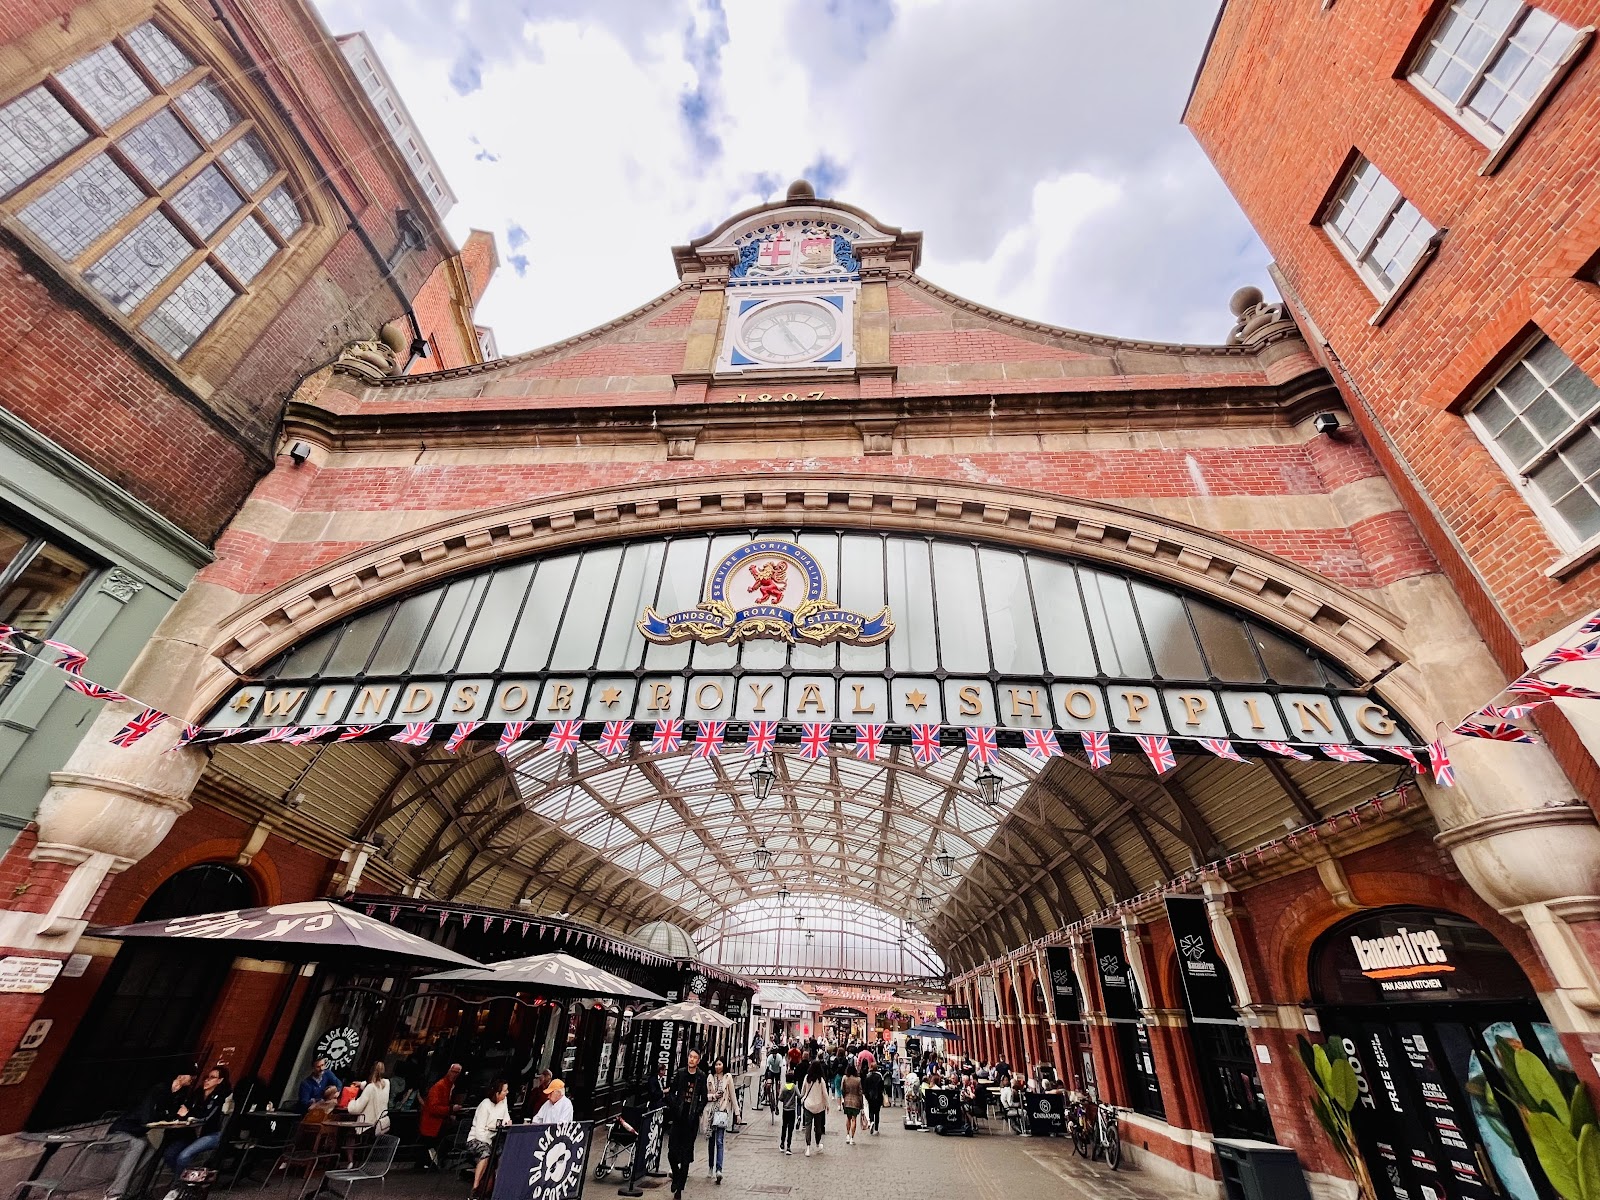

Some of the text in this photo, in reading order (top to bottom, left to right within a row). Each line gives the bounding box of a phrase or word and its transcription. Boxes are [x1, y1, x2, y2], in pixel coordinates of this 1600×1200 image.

[713, 543, 819, 596] SERVIRE GLORIA QUALITAS
[668, 607, 864, 625] WINDSOR ROYAL STATION
[262, 683, 1397, 736] WINDSOR ROYAL SHOPPING
[1381, 978, 1442, 991] PAN ASIAN KITCHEN
[317, 1026, 360, 1050] BLACK SHEEP
[660, 1021, 674, 1050] SHEEP
[1342, 1038, 1376, 1109] 1000
[1380, 1070, 1403, 1112] FREE
[1032, 1111, 1061, 1119] CINNAMON
[529, 1121, 584, 1186] BLACK SHEEP
[542, 1162, 582, 1200] COFFEE
